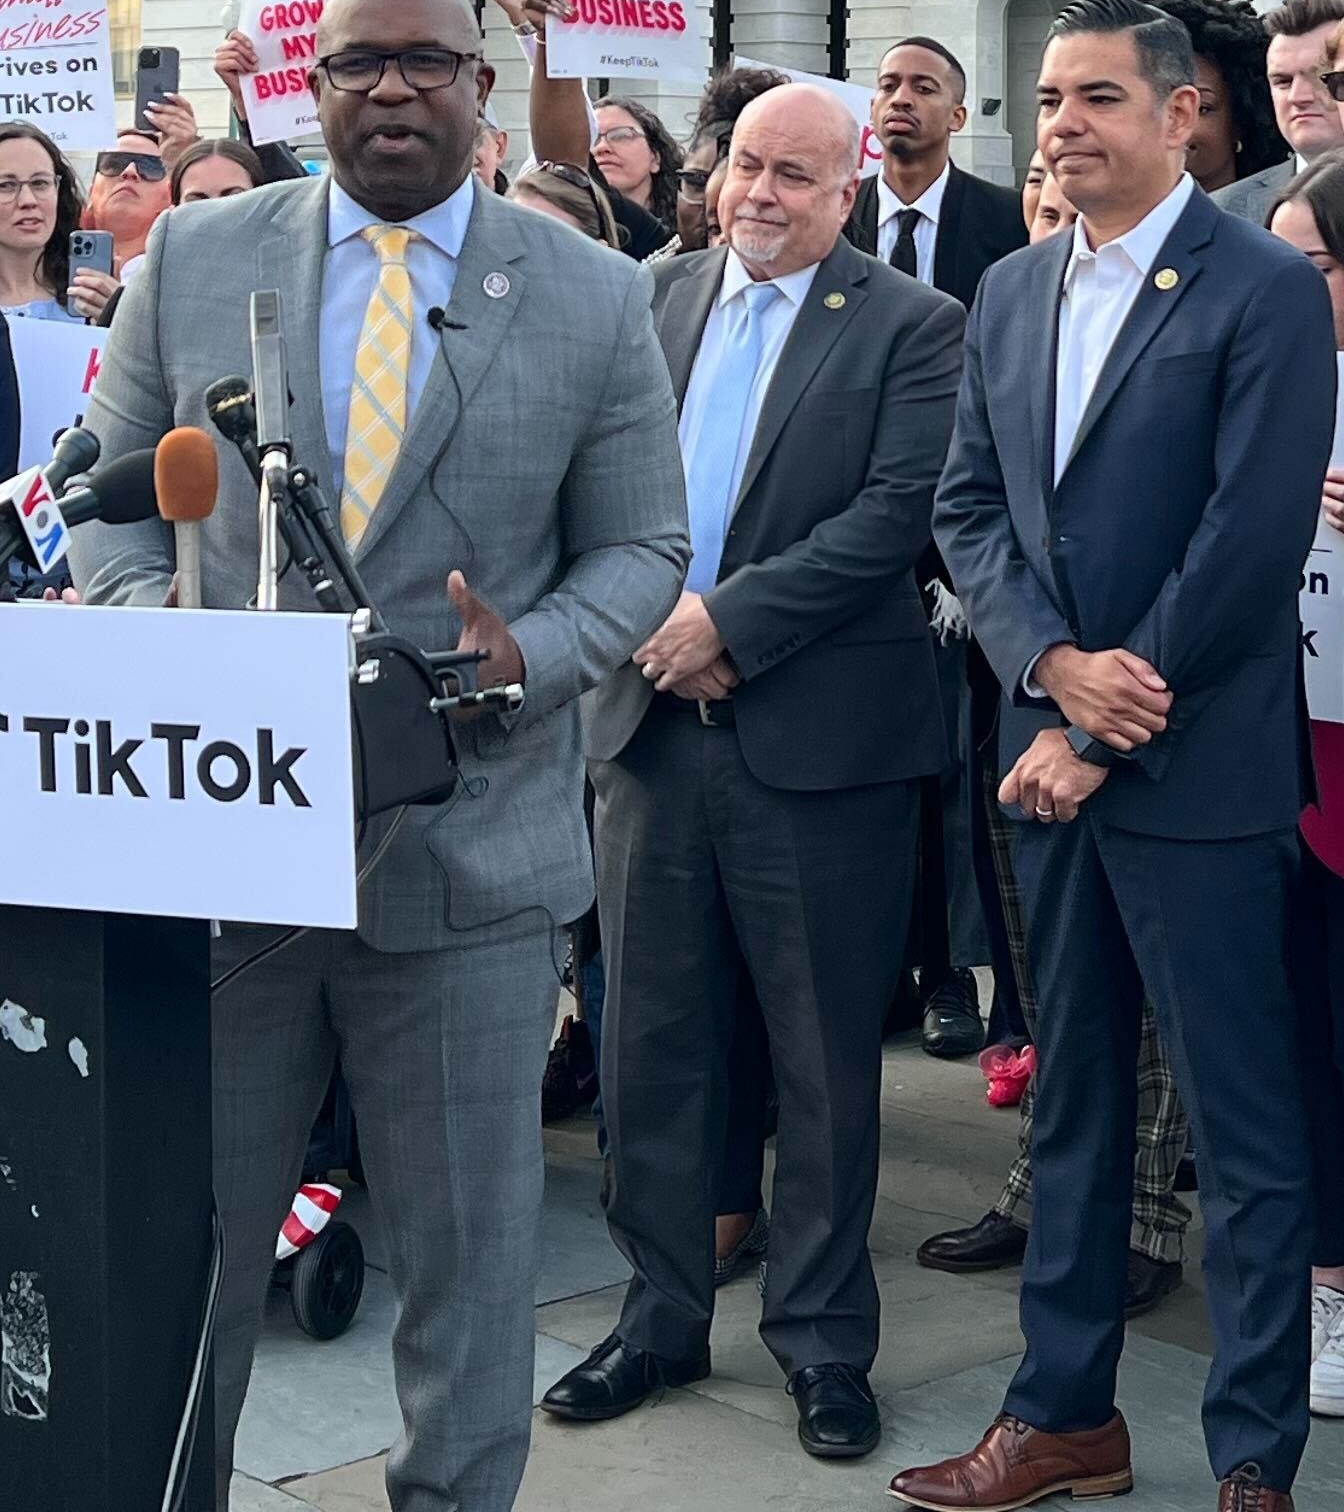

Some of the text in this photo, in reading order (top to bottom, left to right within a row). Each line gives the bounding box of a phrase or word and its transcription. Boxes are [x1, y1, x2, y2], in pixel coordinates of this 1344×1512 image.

[281, 33, 317, 61] MY
[66, 56, 98, 72] on
[0, 90, 95, 114] TikTok
[23, 715, 313, 809] TikTok
